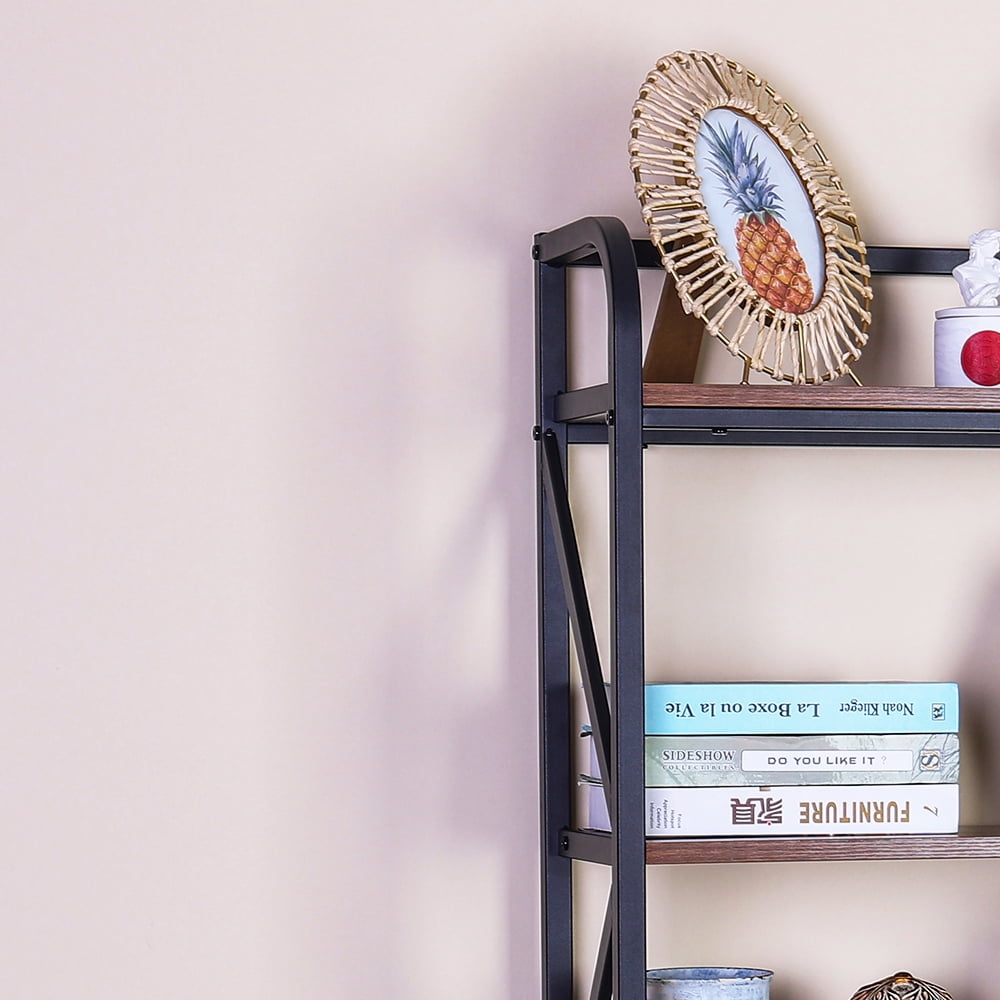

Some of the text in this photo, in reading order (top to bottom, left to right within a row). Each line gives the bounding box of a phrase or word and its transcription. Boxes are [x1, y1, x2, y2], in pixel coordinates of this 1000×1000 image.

[665, 703, 820, 717] La Boxe ou la Vie
[839, 699, 915, 716] Noah Klieger
[662, 750, 735, 761] SIDESHOW
[767, 757, 788, 765] DO
[793, 756, 821, 765] YOU
[826, 756, 857, 765] LIKE
[862, 756, 876, 765] IT
[730, 798, 783, 826] 家具
[799, 801, 910, 824] FURNITURE
